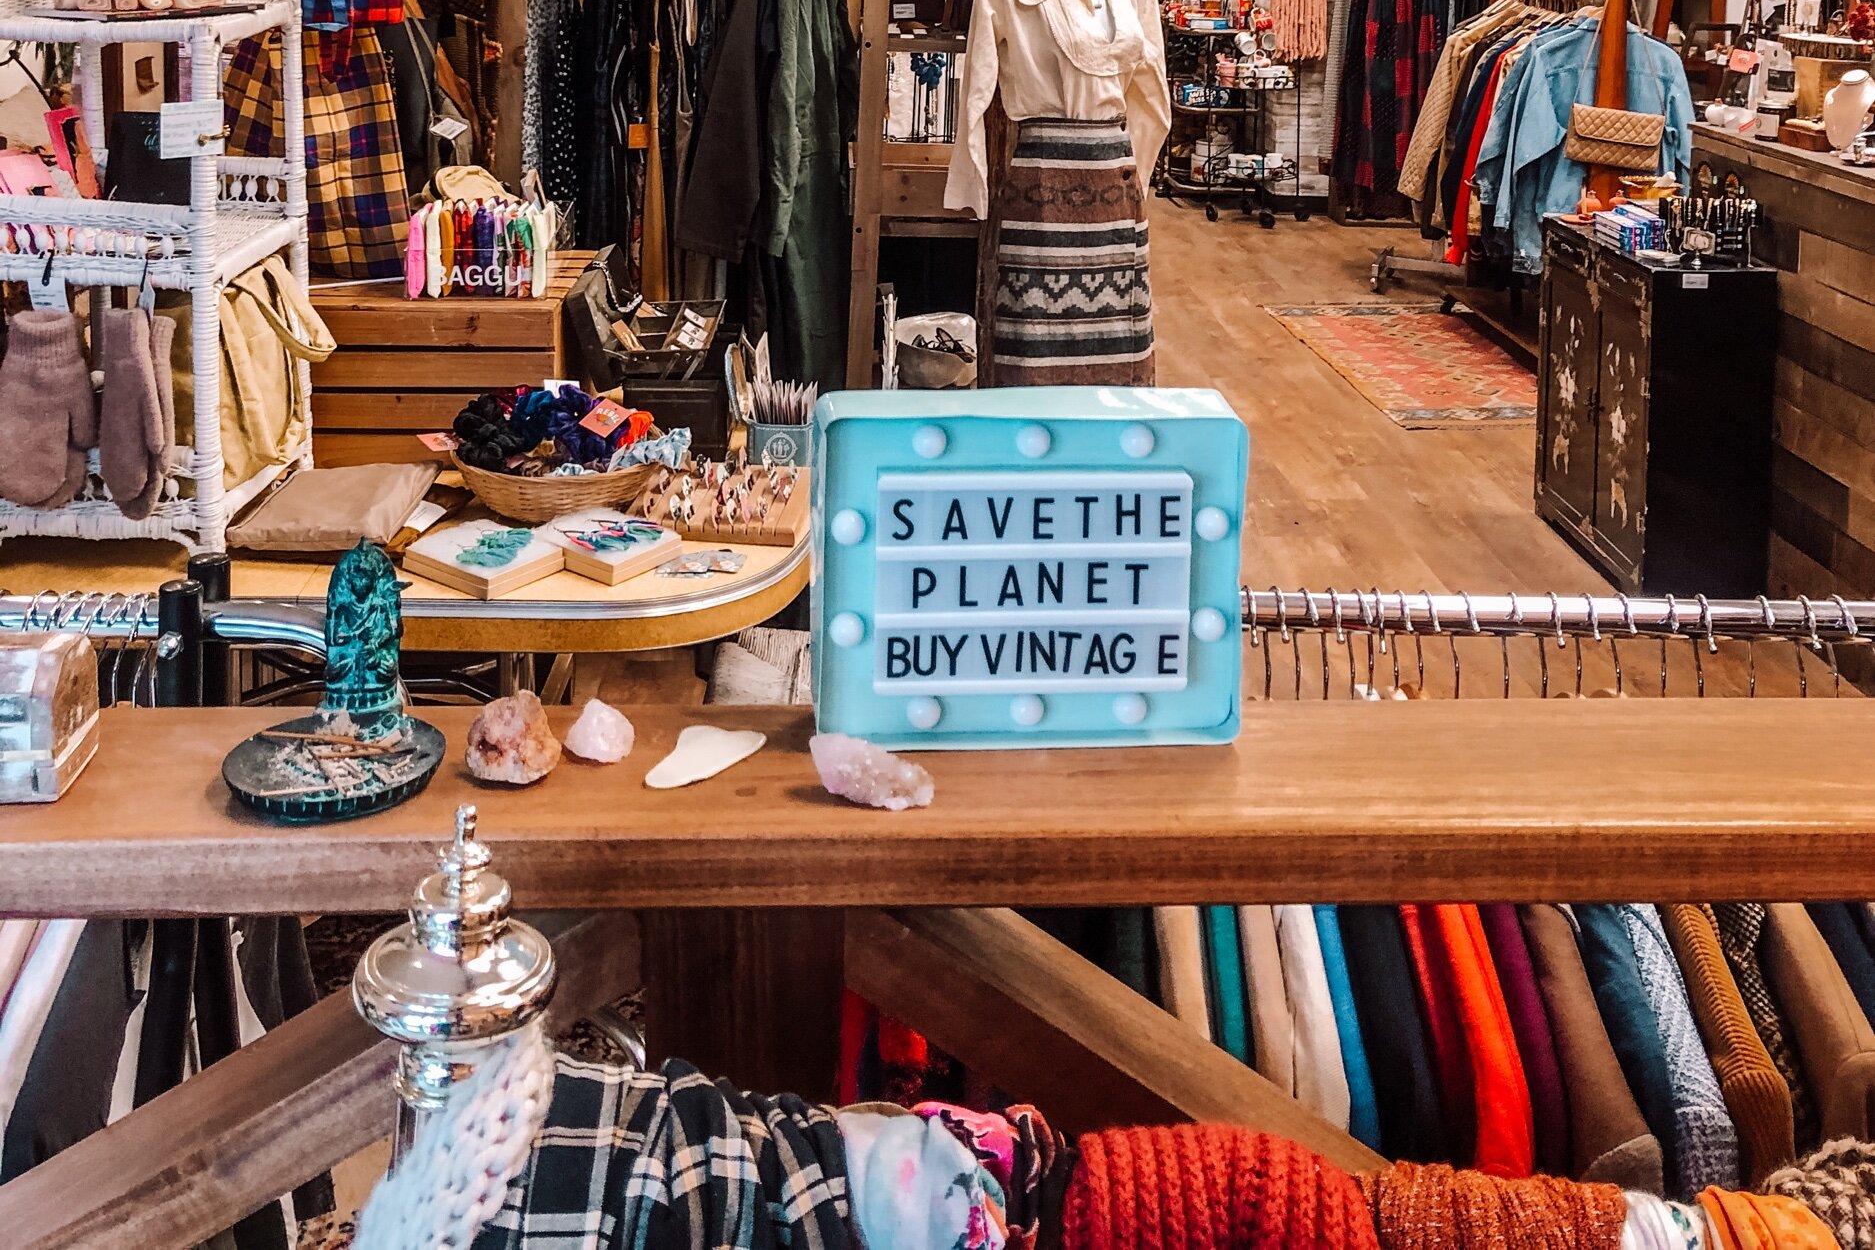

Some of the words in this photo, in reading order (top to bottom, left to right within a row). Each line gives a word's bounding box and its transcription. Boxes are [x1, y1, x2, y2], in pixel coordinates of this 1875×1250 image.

[431, 265, 521, 286] BAGGU
[891, 496, 1056, 541] SAVE
[1074, 493, 1182, 539] THE
[911, 561, 1149, 609] PLANET
[886, 634, 969, 679] BUY
[980, 629, 1180, 676] VINTAGE
